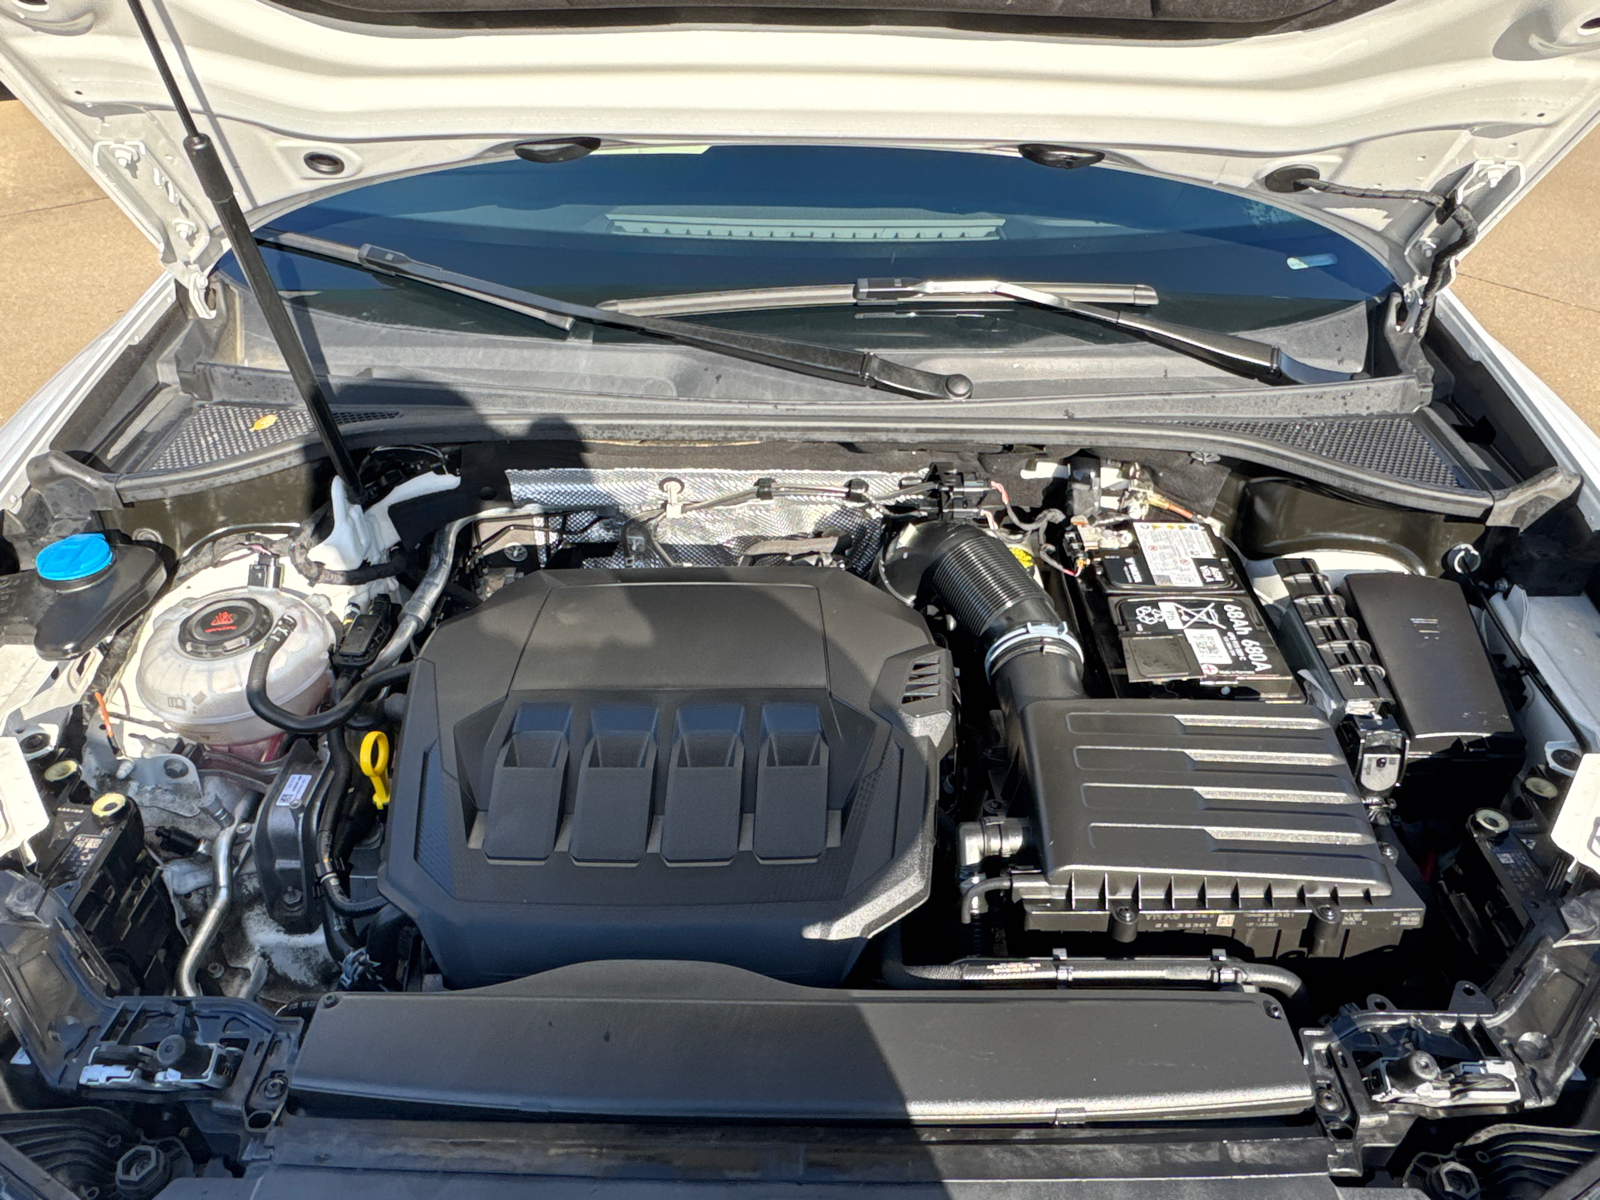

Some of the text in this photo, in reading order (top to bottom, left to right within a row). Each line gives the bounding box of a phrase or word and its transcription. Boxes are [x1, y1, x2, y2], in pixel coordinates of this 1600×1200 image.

[1165, 610, 1175, 620] Pb
[1223, 604, 1253, 635] 68Ah
[1241, 639, 1272, 672] 680A
